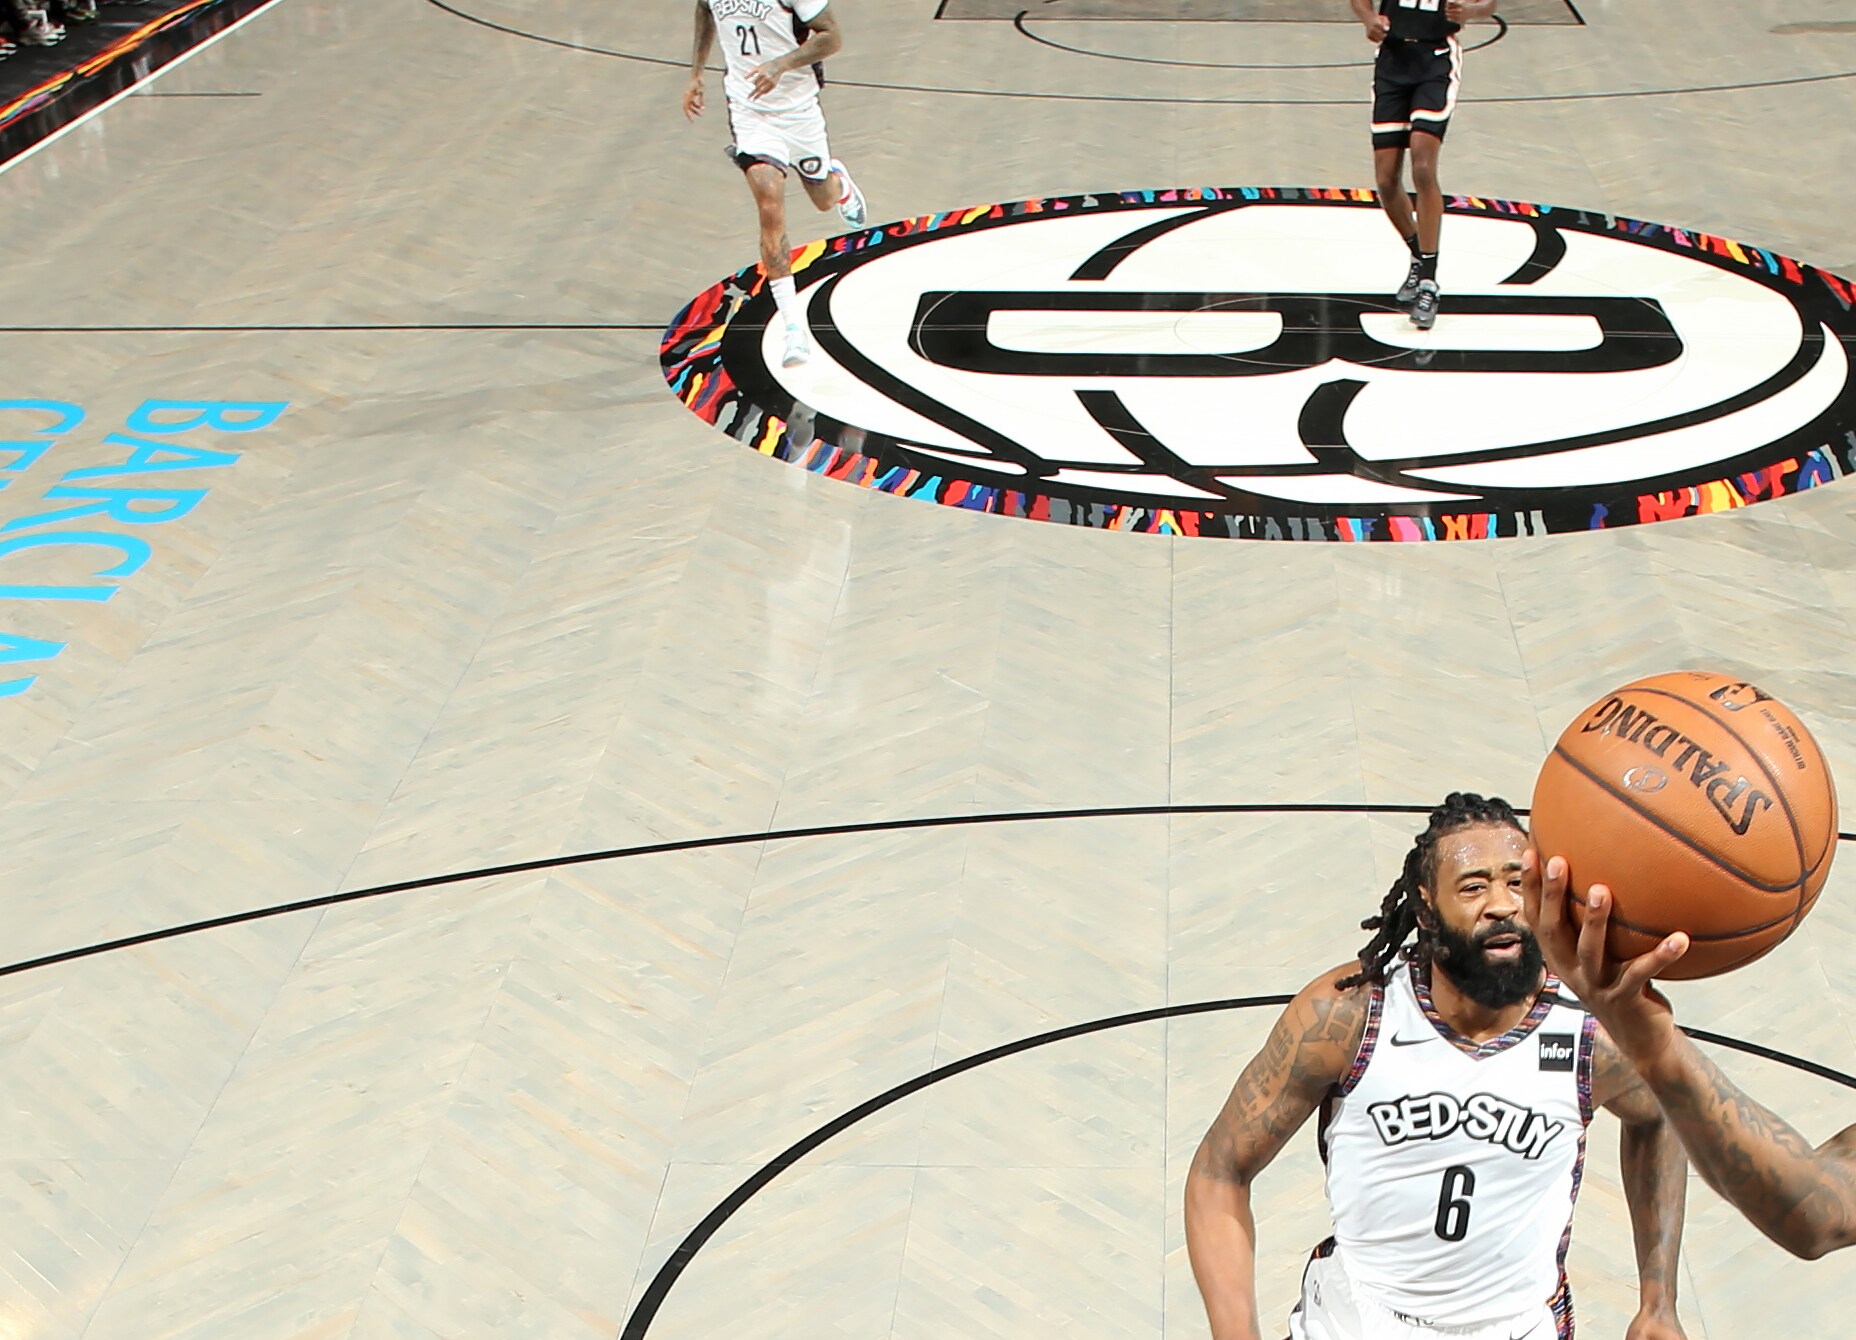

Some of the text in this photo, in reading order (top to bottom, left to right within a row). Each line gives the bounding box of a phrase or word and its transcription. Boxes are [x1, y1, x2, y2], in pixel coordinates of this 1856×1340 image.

[736, 25, 761, 56] 21
[1580, 696, 1773, 836] SPALDING
[1540, 1044, 1573, 1060] infor
[1434, 1165, 1476, 1242] 6
